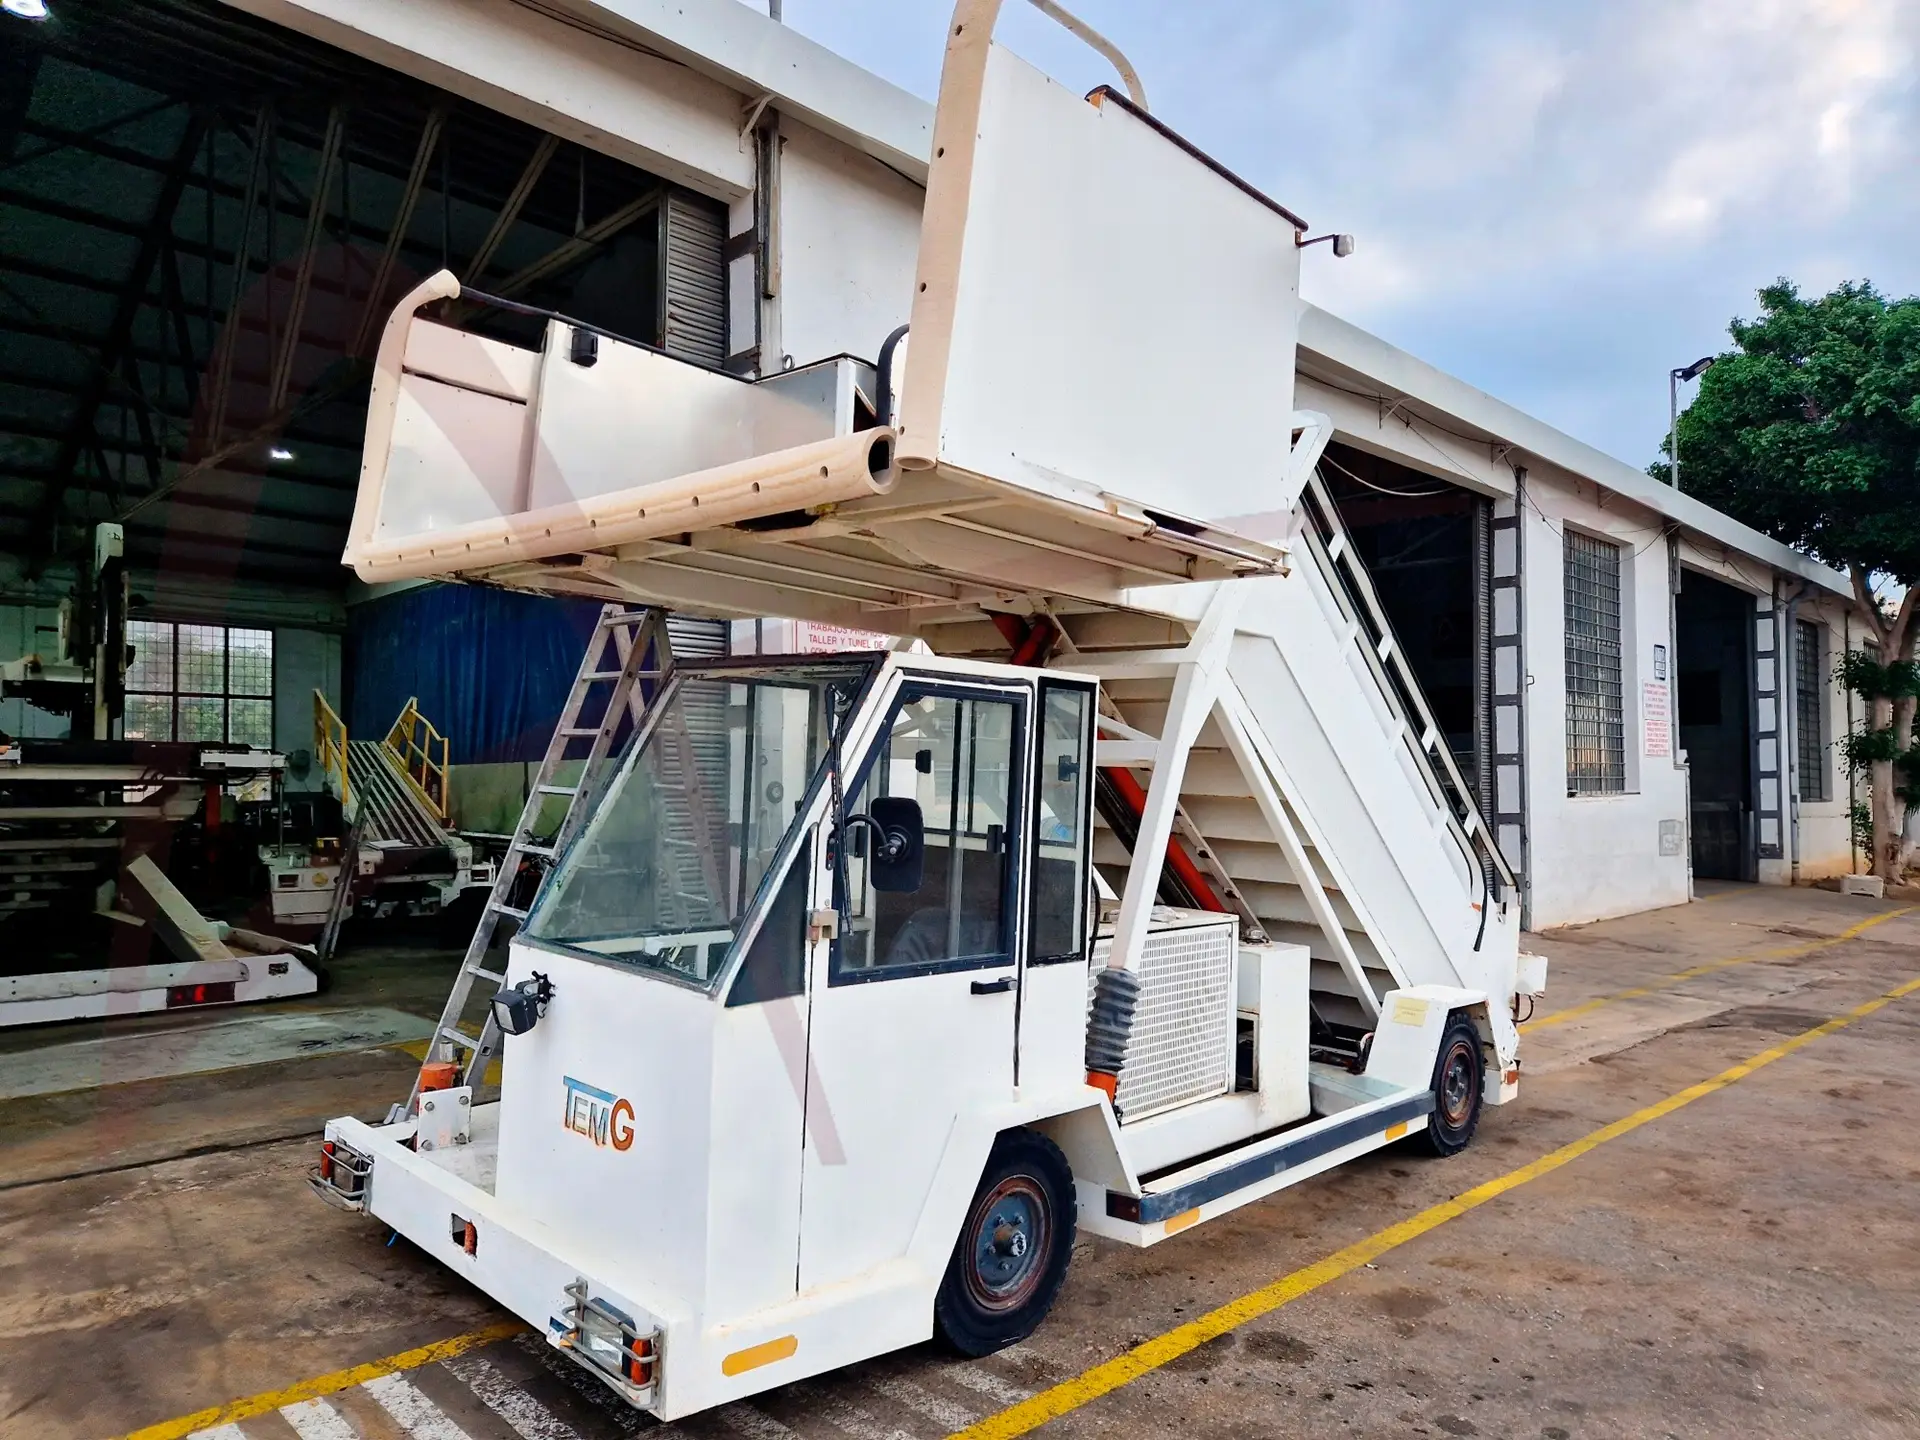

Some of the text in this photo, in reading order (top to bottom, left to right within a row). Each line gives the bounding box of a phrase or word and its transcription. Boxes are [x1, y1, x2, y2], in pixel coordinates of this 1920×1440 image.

[807, 622, 847, 634] TRABAJOS
[809, 634, 837, 645] TALLER
[848, 638, 871, 649] TUNEL
[874, 641, 884, 649] DE
[563, 1075, 635, 1151] TEMG
